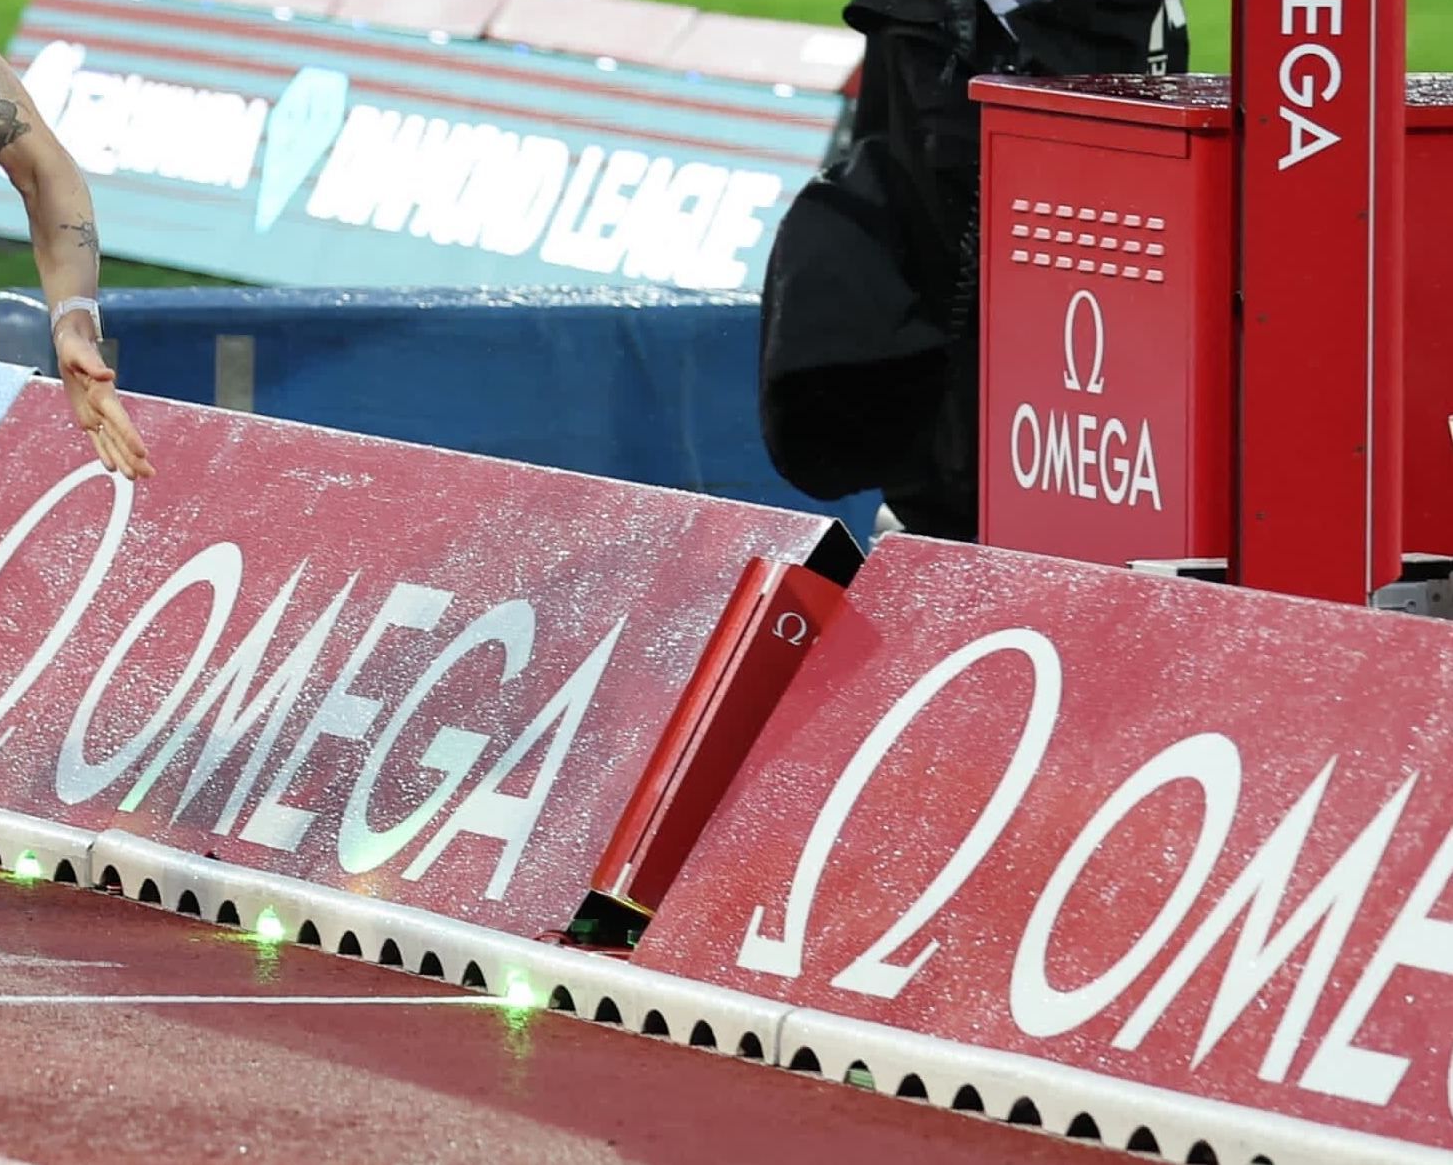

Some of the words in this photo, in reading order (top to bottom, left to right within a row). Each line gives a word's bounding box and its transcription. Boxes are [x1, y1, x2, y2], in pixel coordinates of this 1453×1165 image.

[1011, 402, 1163, 512] OMEGA
[54, 541, 627, 901] OMEGA
[1008, 731, 1453, 1108] OME
